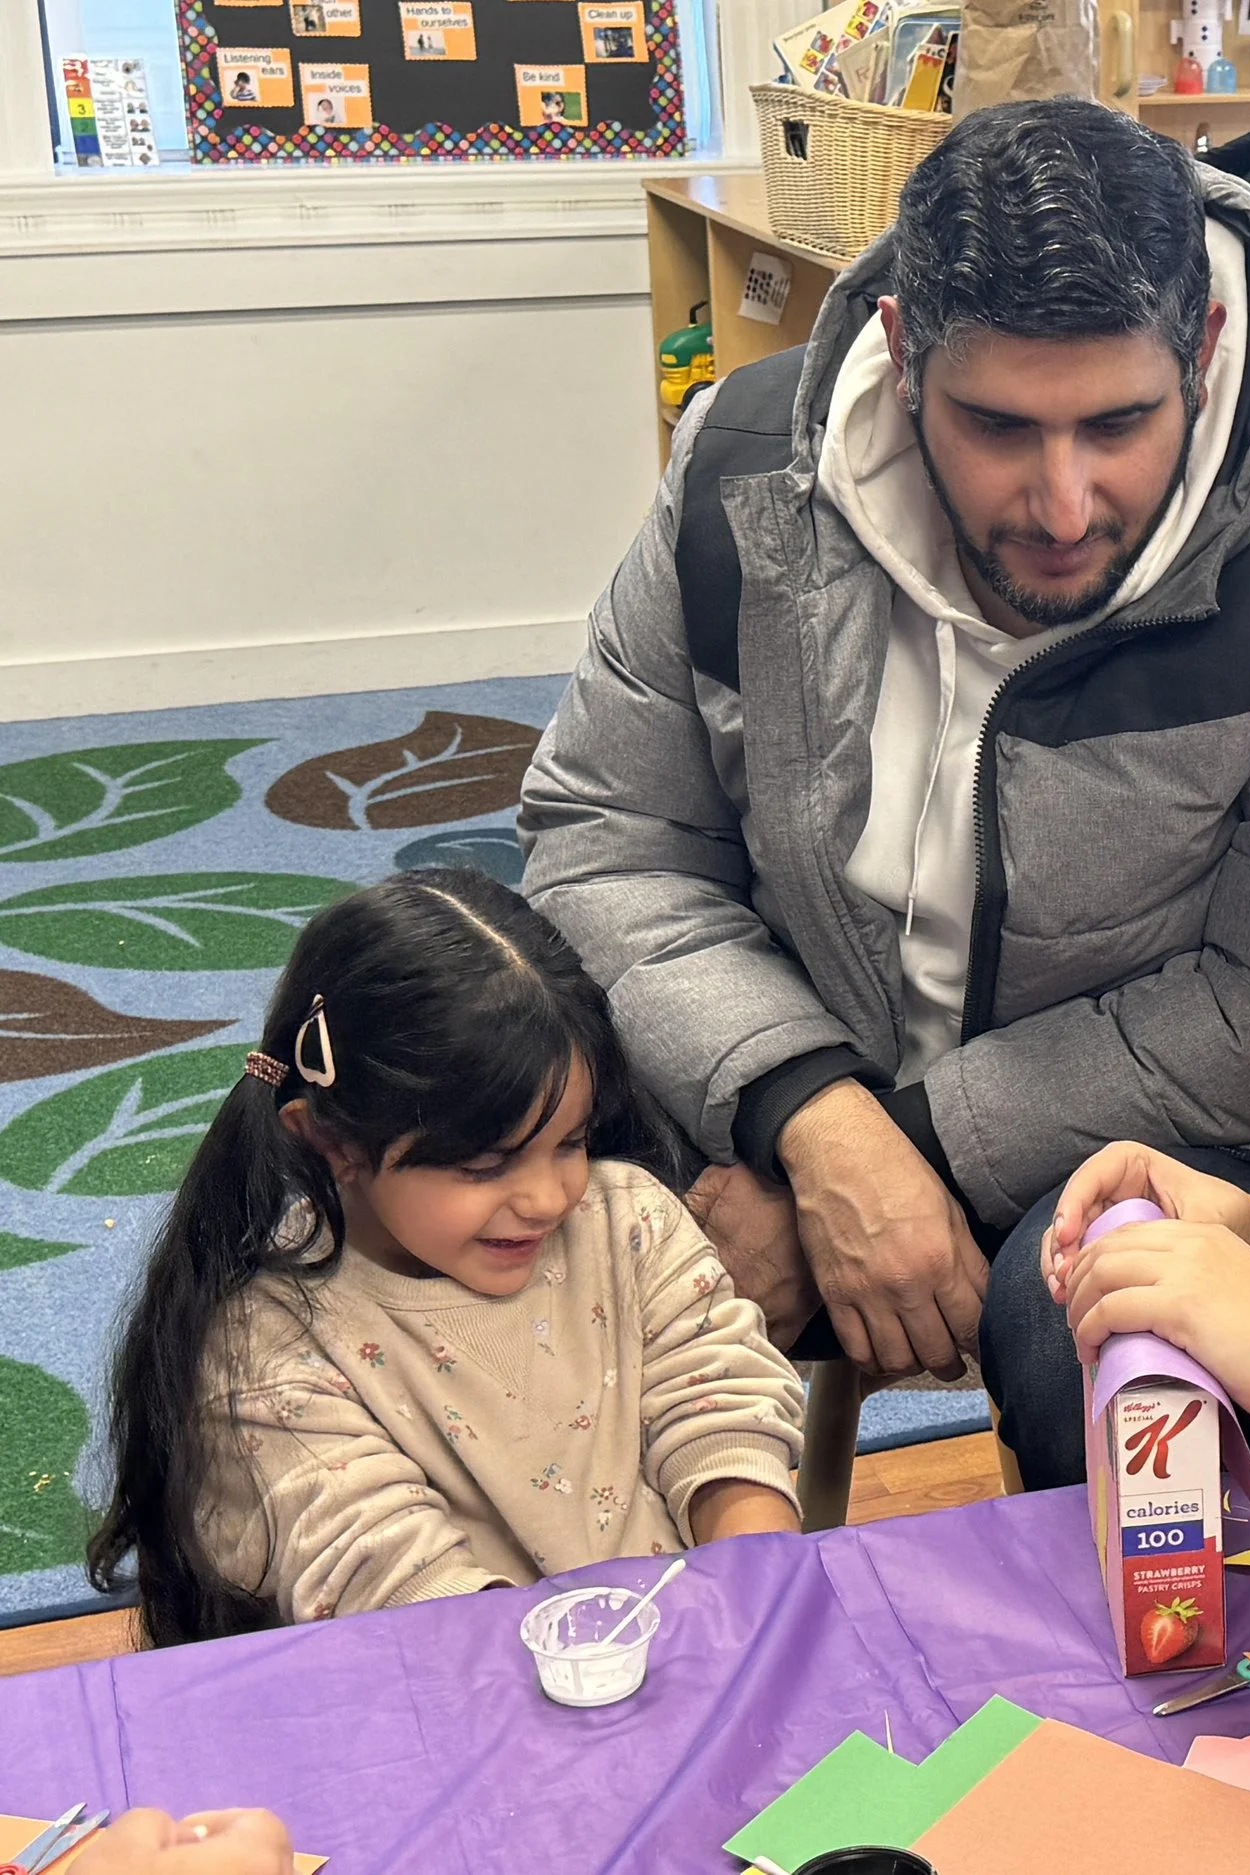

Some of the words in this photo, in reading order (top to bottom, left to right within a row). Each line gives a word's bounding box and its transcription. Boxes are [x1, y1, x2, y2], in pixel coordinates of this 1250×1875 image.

[326, 9, 352, 17] other
[406, 7, 439, 15] Hands
[441, 6, 452, 15] to
[588, 9, 617, 19] Clean
[620, 11, 633, 20] up
[421, 18, 468, 27] ourselves
[224, 53, 272, 64] Listening
[261, 66, 285, 75] ears
[310, 69, 342, 79] Inside
[523, 72, 536, 82] Be
[539, 71, 560, 82] kind
[328, 84, 361, 93] voices
[77, 104, 86, 115] 3
[1124, 1415, 1153, 1423] SPECIAL
[1125, 1400, 1202, 1479] K
[1127, 1501, 1199, 1518] calories
[1137, 1529, 1184, 1549] 100
[1133, 1565, 1205, 1581] STRAWBERRY
[1138, 1583, 1170, 1593] PASTRY
[1171, 1580, 1202, 1590] CRISPS
